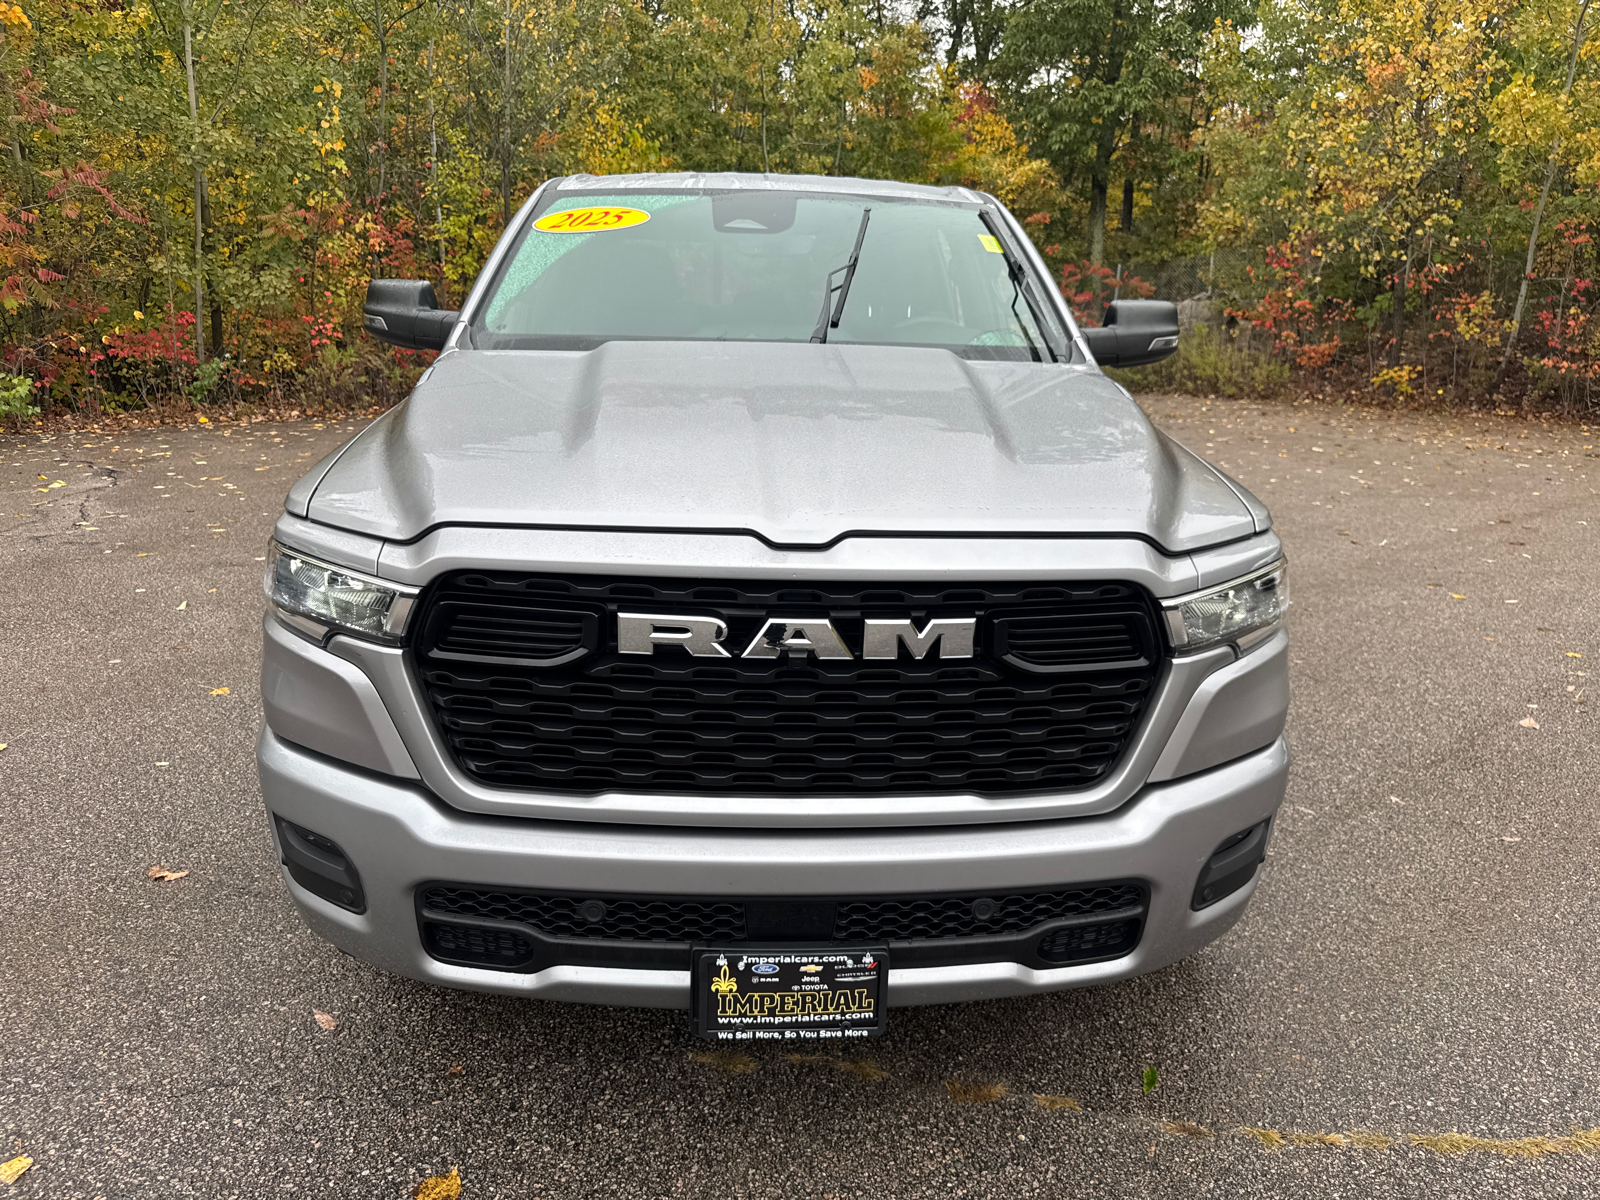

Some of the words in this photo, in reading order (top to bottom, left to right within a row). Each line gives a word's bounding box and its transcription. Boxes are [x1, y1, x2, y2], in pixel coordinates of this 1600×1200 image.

[547, 211, 632, 229] 2025
[617, 612, 977, 660] RAM
[742, 955, 848, 965] Imperialcars.com
[801, 975, 820, 983] Jeep
[717, 989, 874, 1016] IMPERIAL
[717, 1011, 874, 1025] www.imperialcars.com
[717, 1031, 733, 1039] We
[735, 1031, 753, 1039] Sell
[755, 1030, 782, 1039] More,
[784, 1030, 797, 1038] So
[799, 1030, 817, 1038] You
[819, 1029, 842, 1037] Save
[844, 1029, 868, 1037] More
